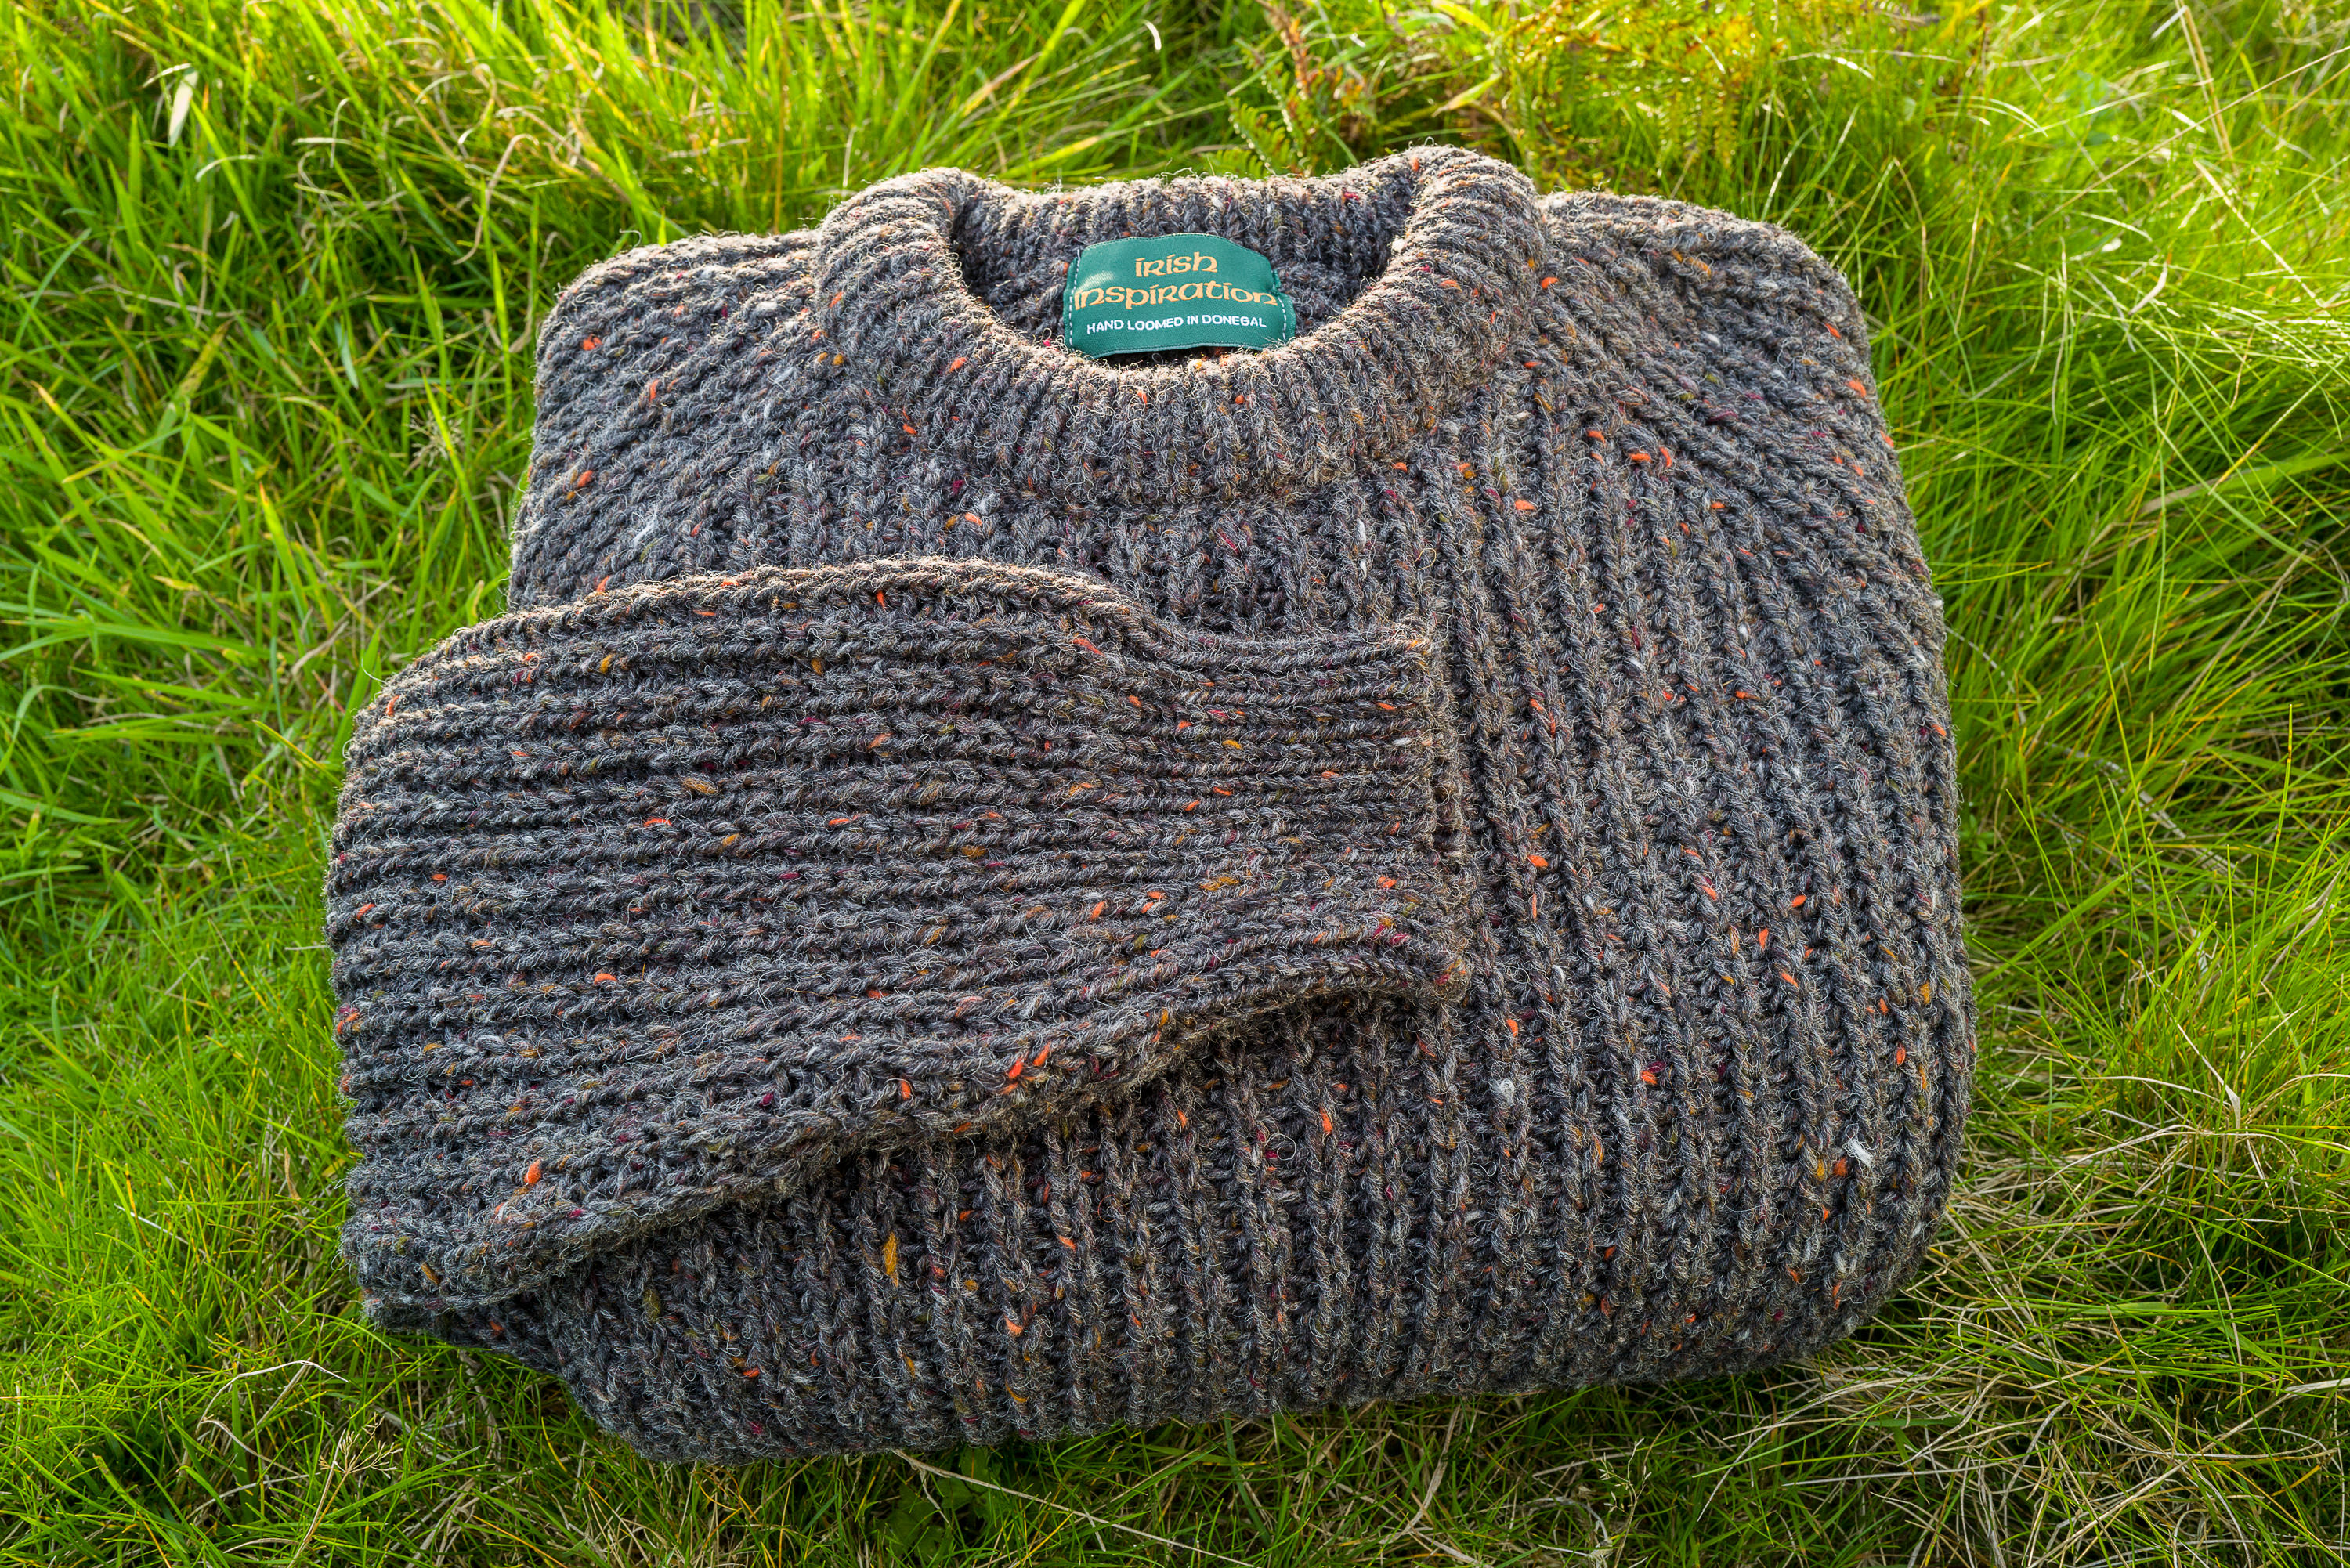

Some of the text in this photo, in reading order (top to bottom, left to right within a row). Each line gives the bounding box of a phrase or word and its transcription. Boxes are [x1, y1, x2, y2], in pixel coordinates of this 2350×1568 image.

[1086, 314, 1267, 334] HAND LOOMED IN DONEGAL
